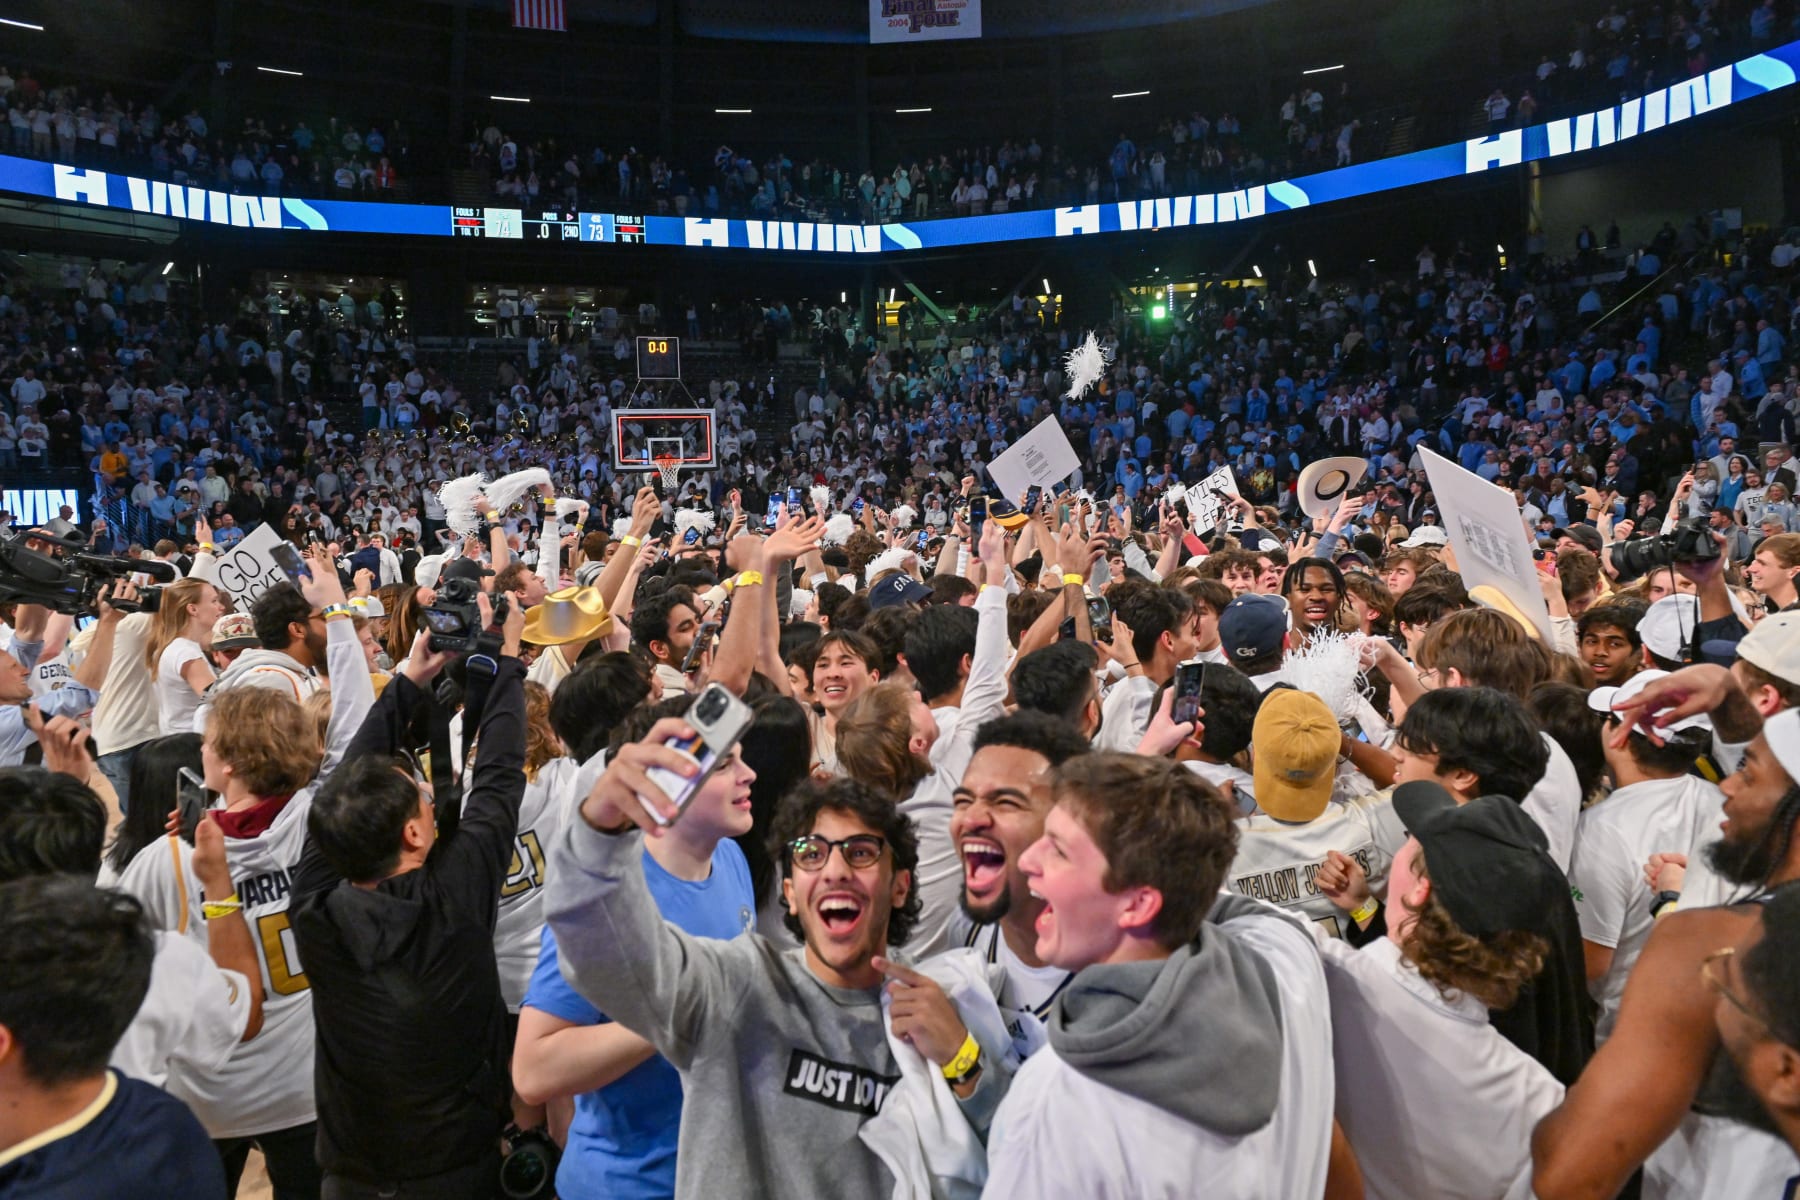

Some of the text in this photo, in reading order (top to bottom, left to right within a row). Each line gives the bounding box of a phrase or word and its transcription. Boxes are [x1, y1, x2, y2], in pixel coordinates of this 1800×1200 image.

[887, 10, 960, 33] 2004 Four
[455, 207, 474, 217] FOULS
[564, 225, 579, 238] 2ND
[588, 224, 605, 241] 73
[1747, 495, 1764, 505] TEC
[218, 550, 261, 593] GO
[1237, 866, 1301, 903] YELLOW
[790, 1058, 853, 1103] JUST
